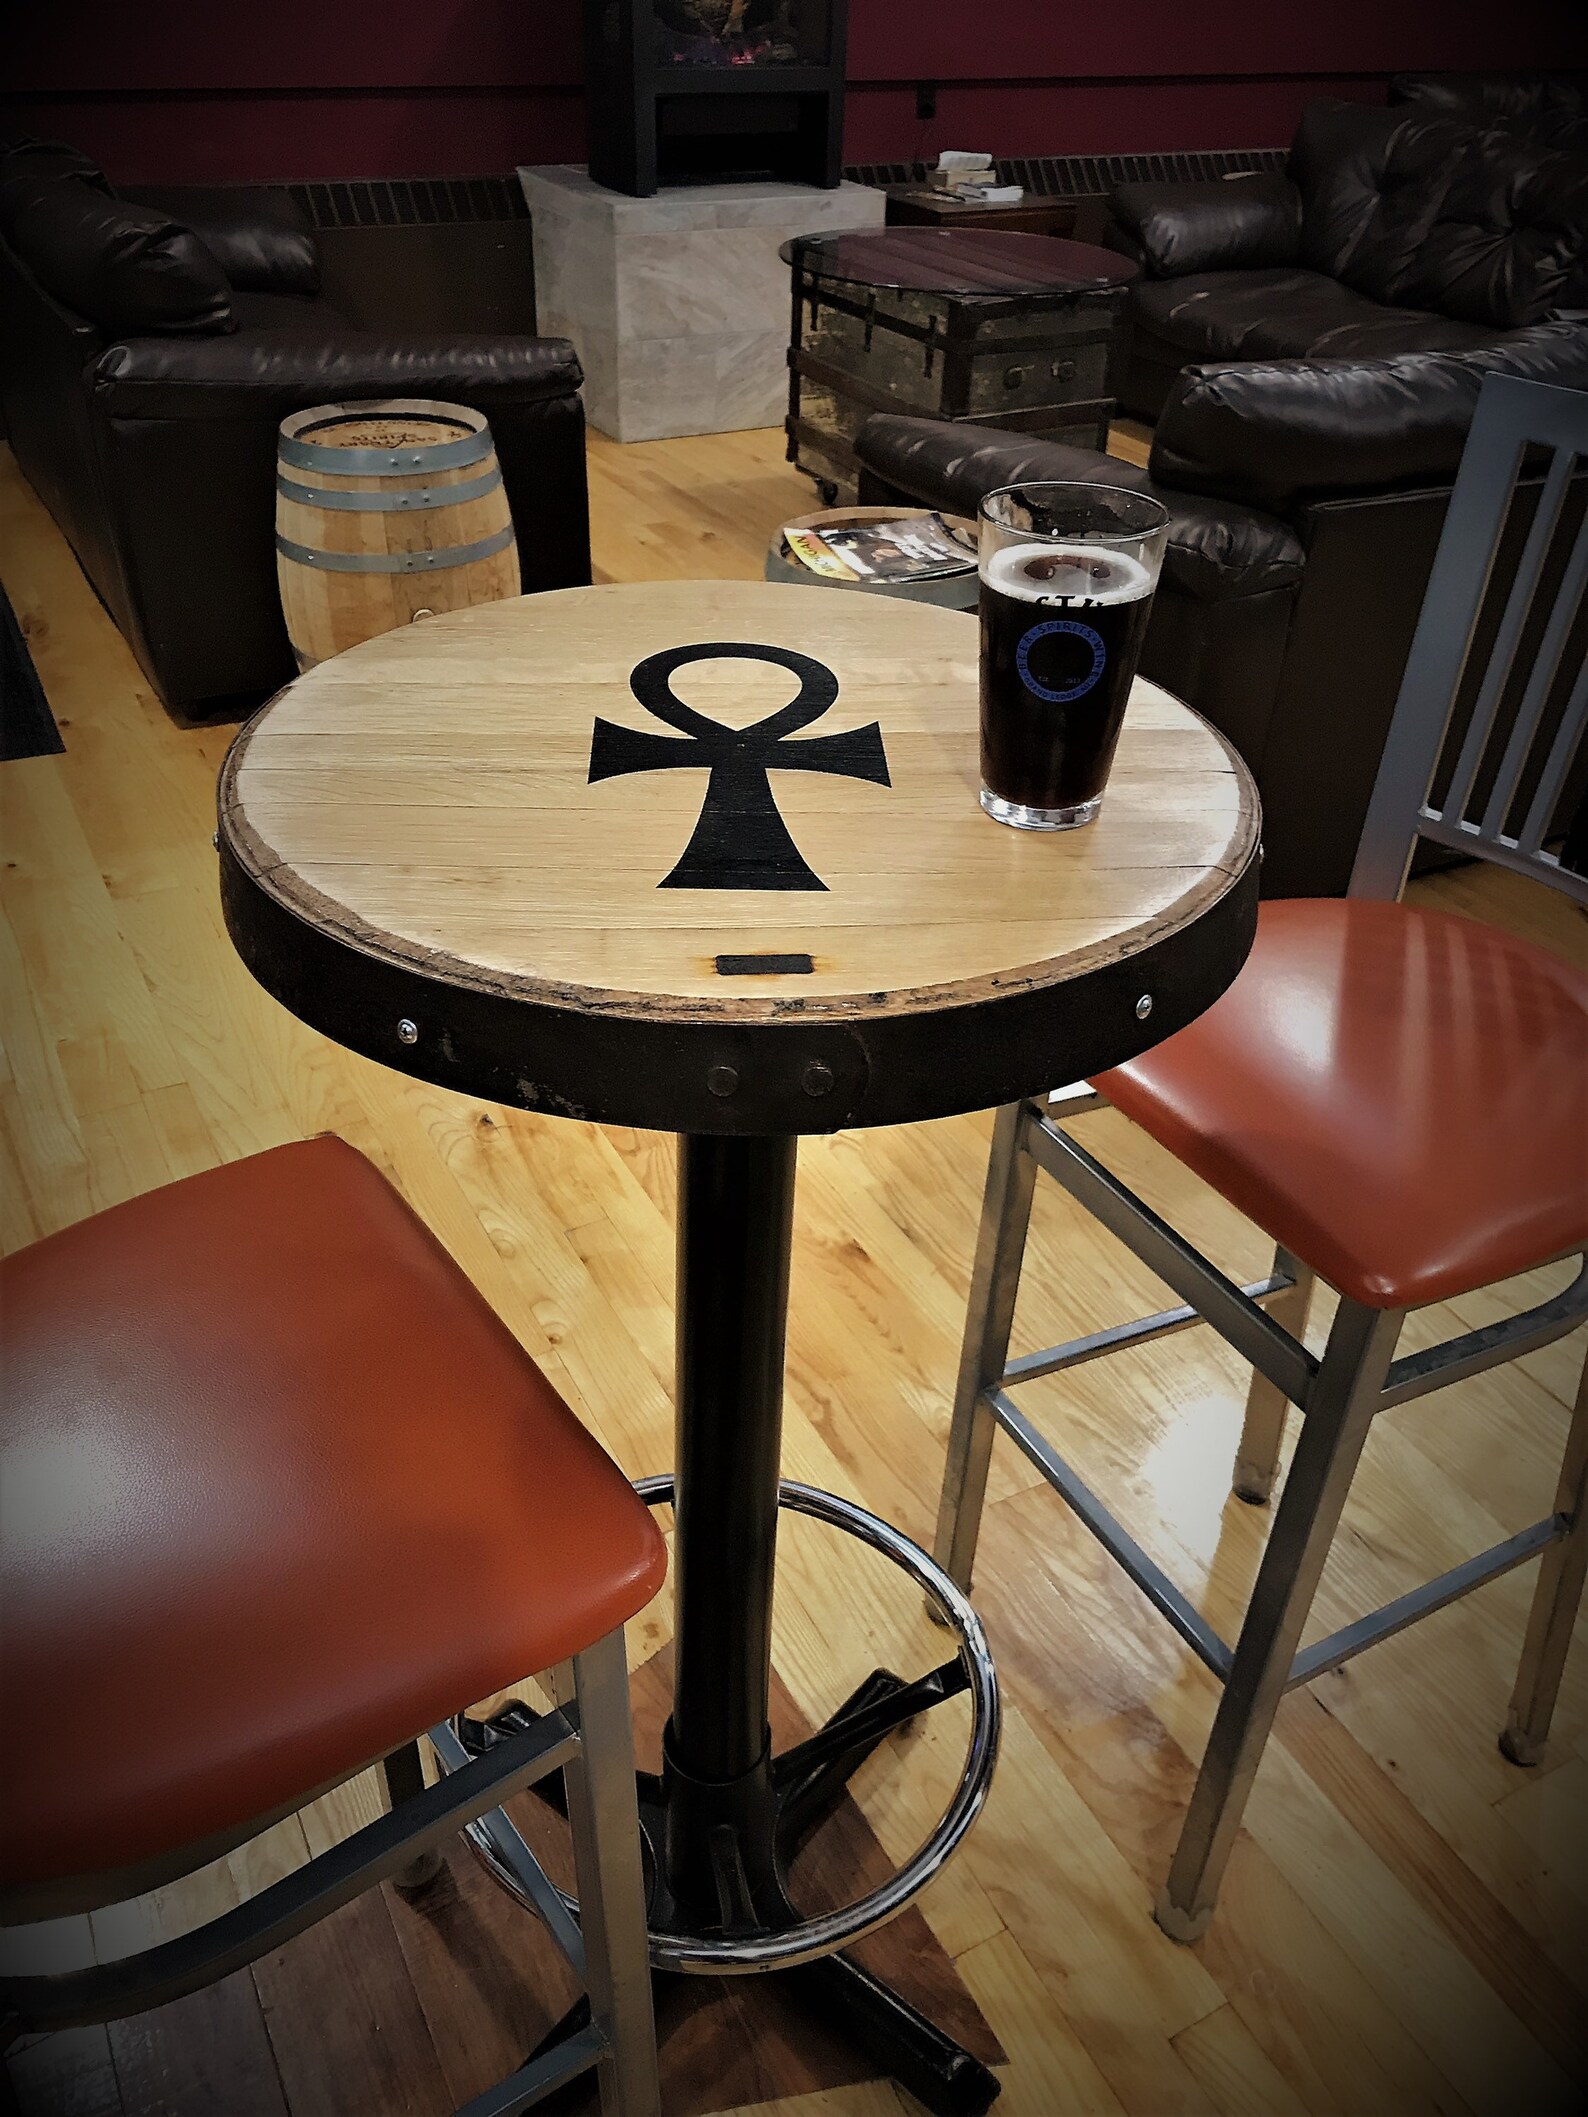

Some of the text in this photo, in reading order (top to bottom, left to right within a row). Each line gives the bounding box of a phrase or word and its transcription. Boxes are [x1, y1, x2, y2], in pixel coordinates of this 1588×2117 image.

[1017, 622, 1105, 677] BEER SPIRITS WINE
